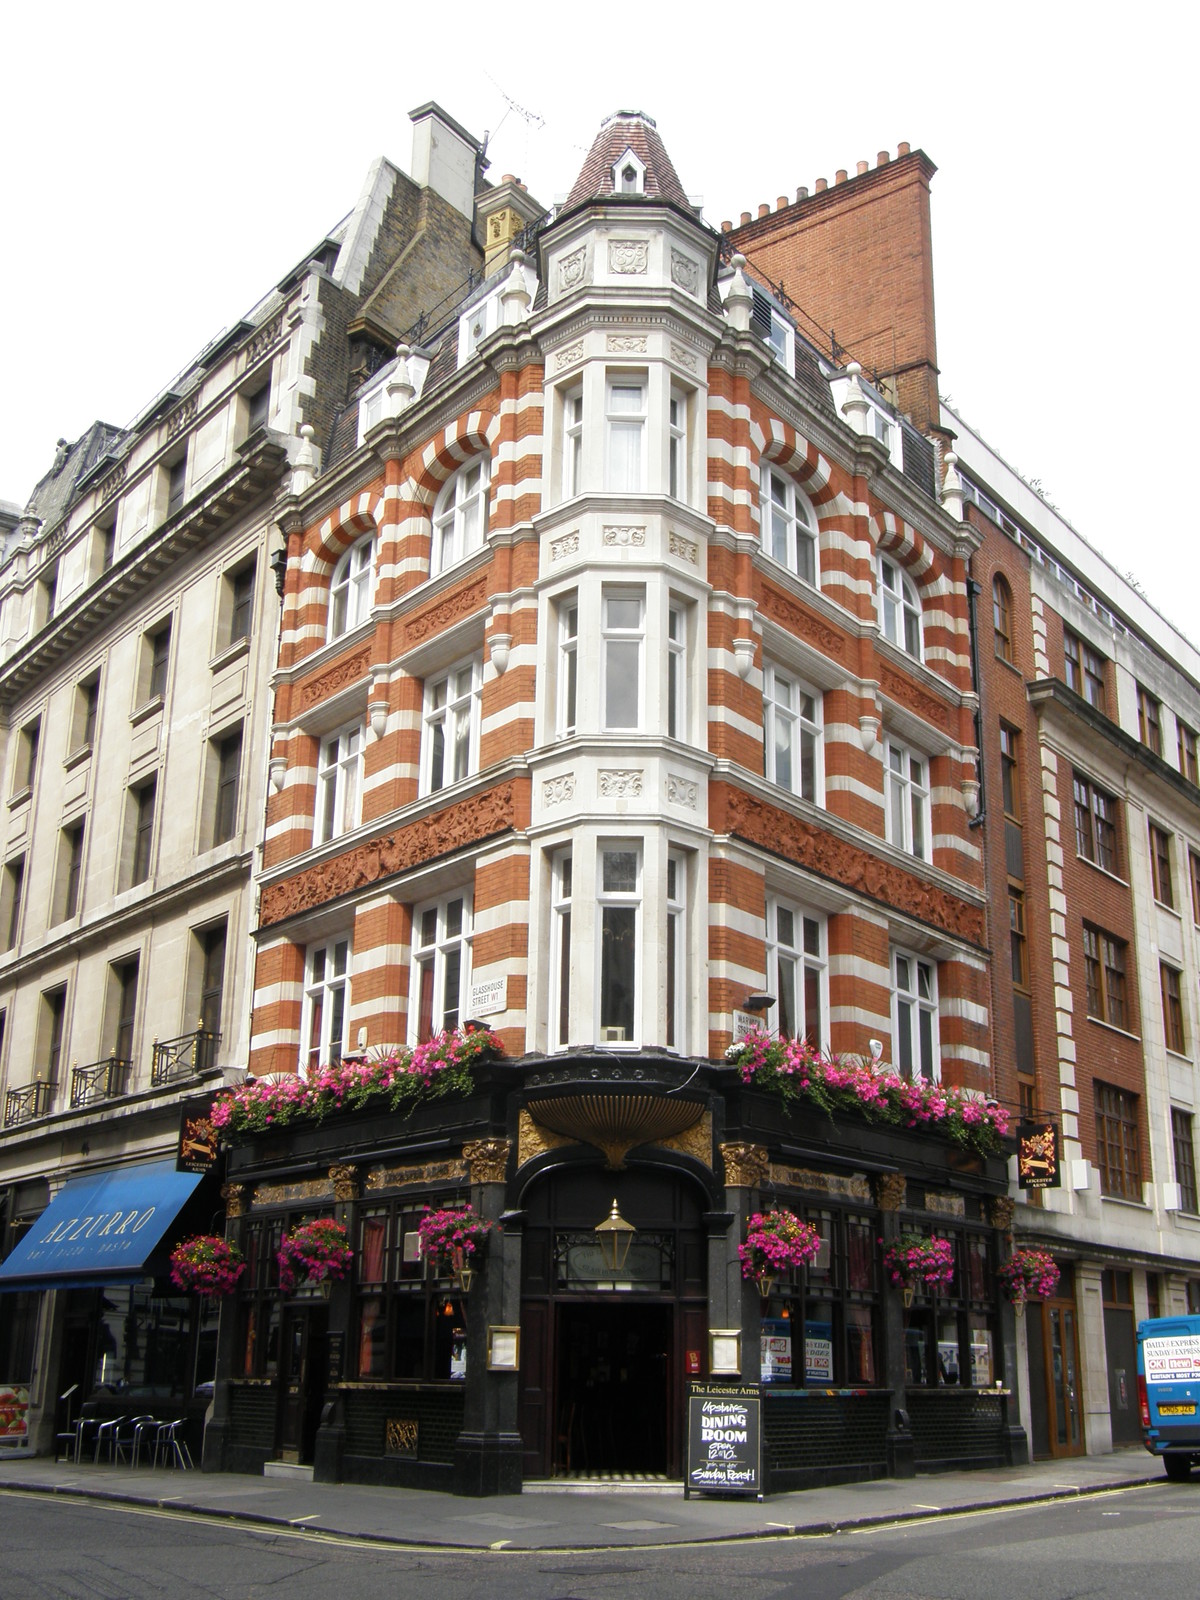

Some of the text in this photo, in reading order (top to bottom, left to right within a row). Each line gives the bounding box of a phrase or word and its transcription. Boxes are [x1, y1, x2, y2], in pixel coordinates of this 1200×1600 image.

[472, 980, 504, 996] GLASSHOUSE
[472, 992, 499, 1006] STREET W1
[39, 1206, 156, 1244] AZZURRO
[96, 1241, 132, 1256] pasta
[1146, 1339, 1200, 1349] DAILY EXPRESS
[1146, 1349, 1171, 1357] SUNDAY
[1150, 1359, 1166, 1369] OK!
[691, 1384, 760, 1395] The Leicester Arms
[702, 1401, 748, 1415] Upstairs
[701, 1414, 747, 1429] DINING
[701, 1428, 747, 1443] ROOM
[709, 1442, 735, 1451] open
[708, 1449, 718, 1459] 12
[691, 1468, 755, 1482] Sunday Roast!
